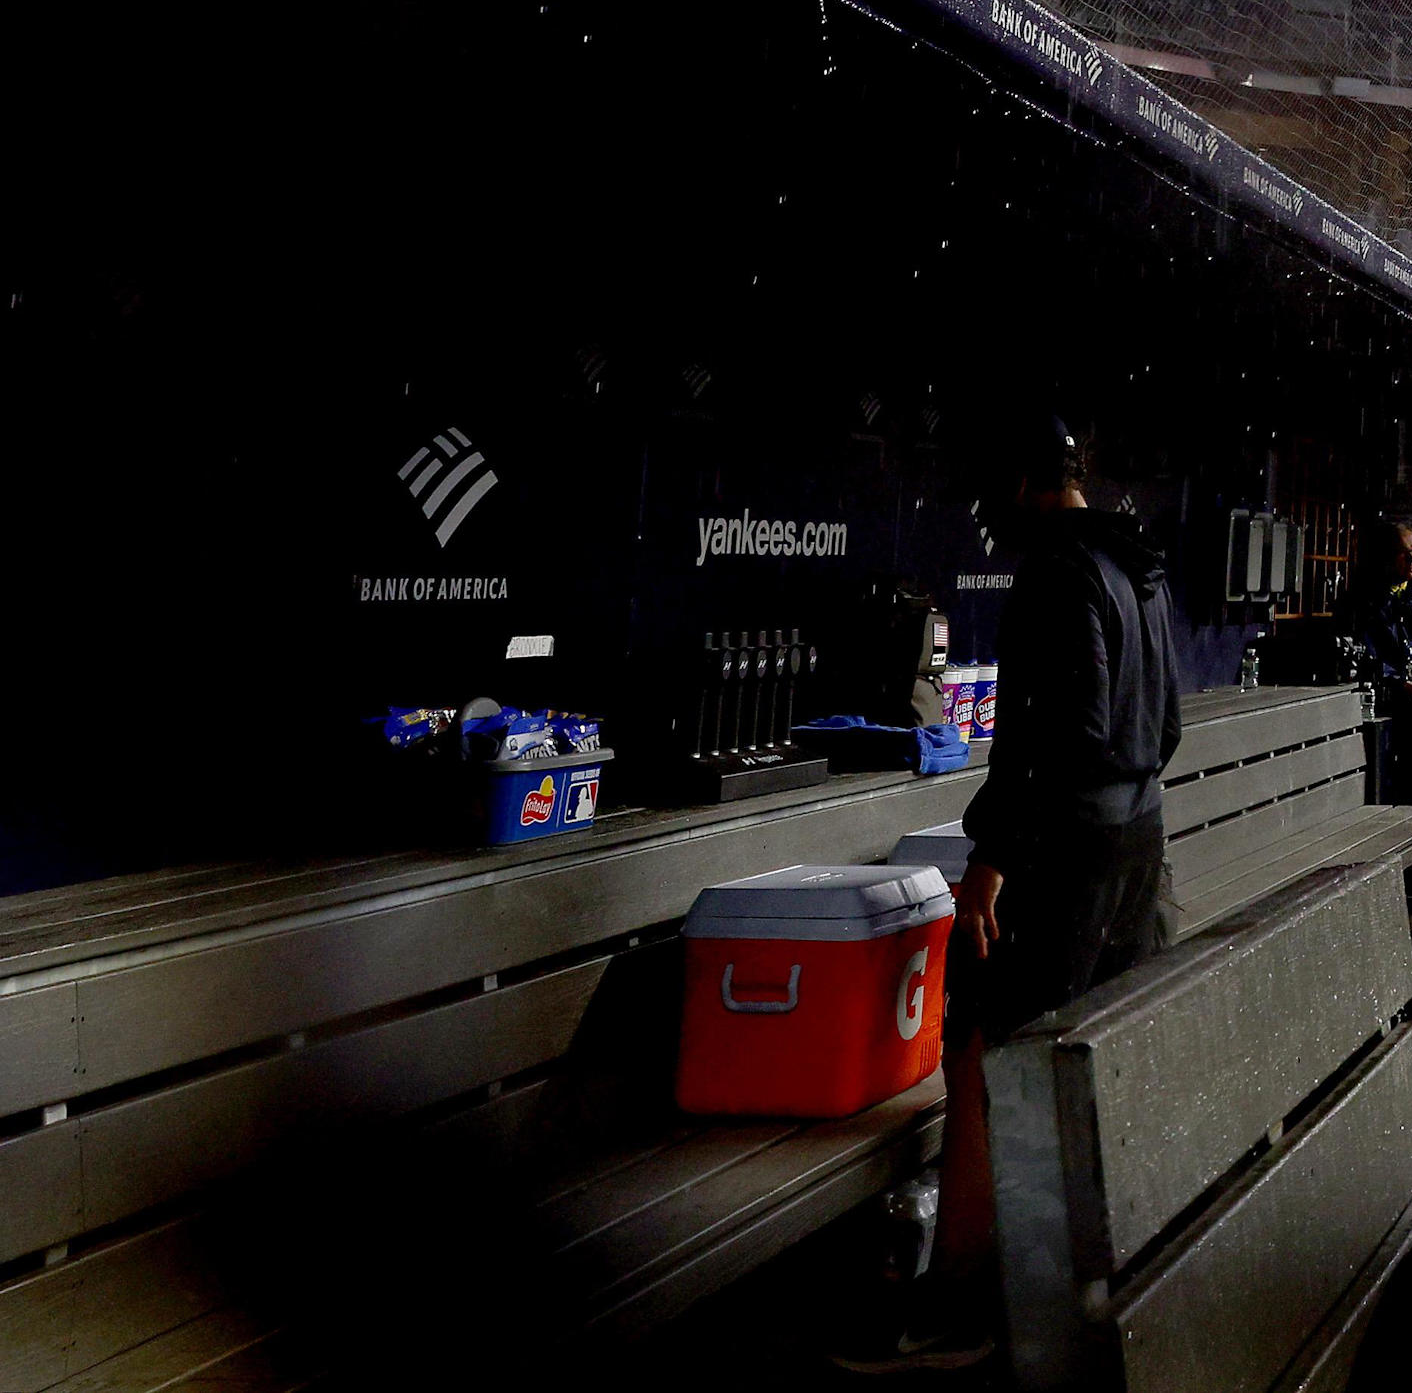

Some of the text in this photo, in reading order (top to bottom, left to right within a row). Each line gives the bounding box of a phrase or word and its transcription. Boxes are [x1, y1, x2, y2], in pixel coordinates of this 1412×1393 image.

[1023, 20, 1039, 46] OF
[1039, 30, 1082, 77] AMERICA
[1138, 96, 1203, 154] BANK OF AMERICA
[696, 508, 847, 566] yankees.com
[360, 577, 508, 602] BANK OF AMERICA
[956, 575, 976, 590] BANK
[976, 575, 985, 589] OF
[896, 946, 929, 1041] G
